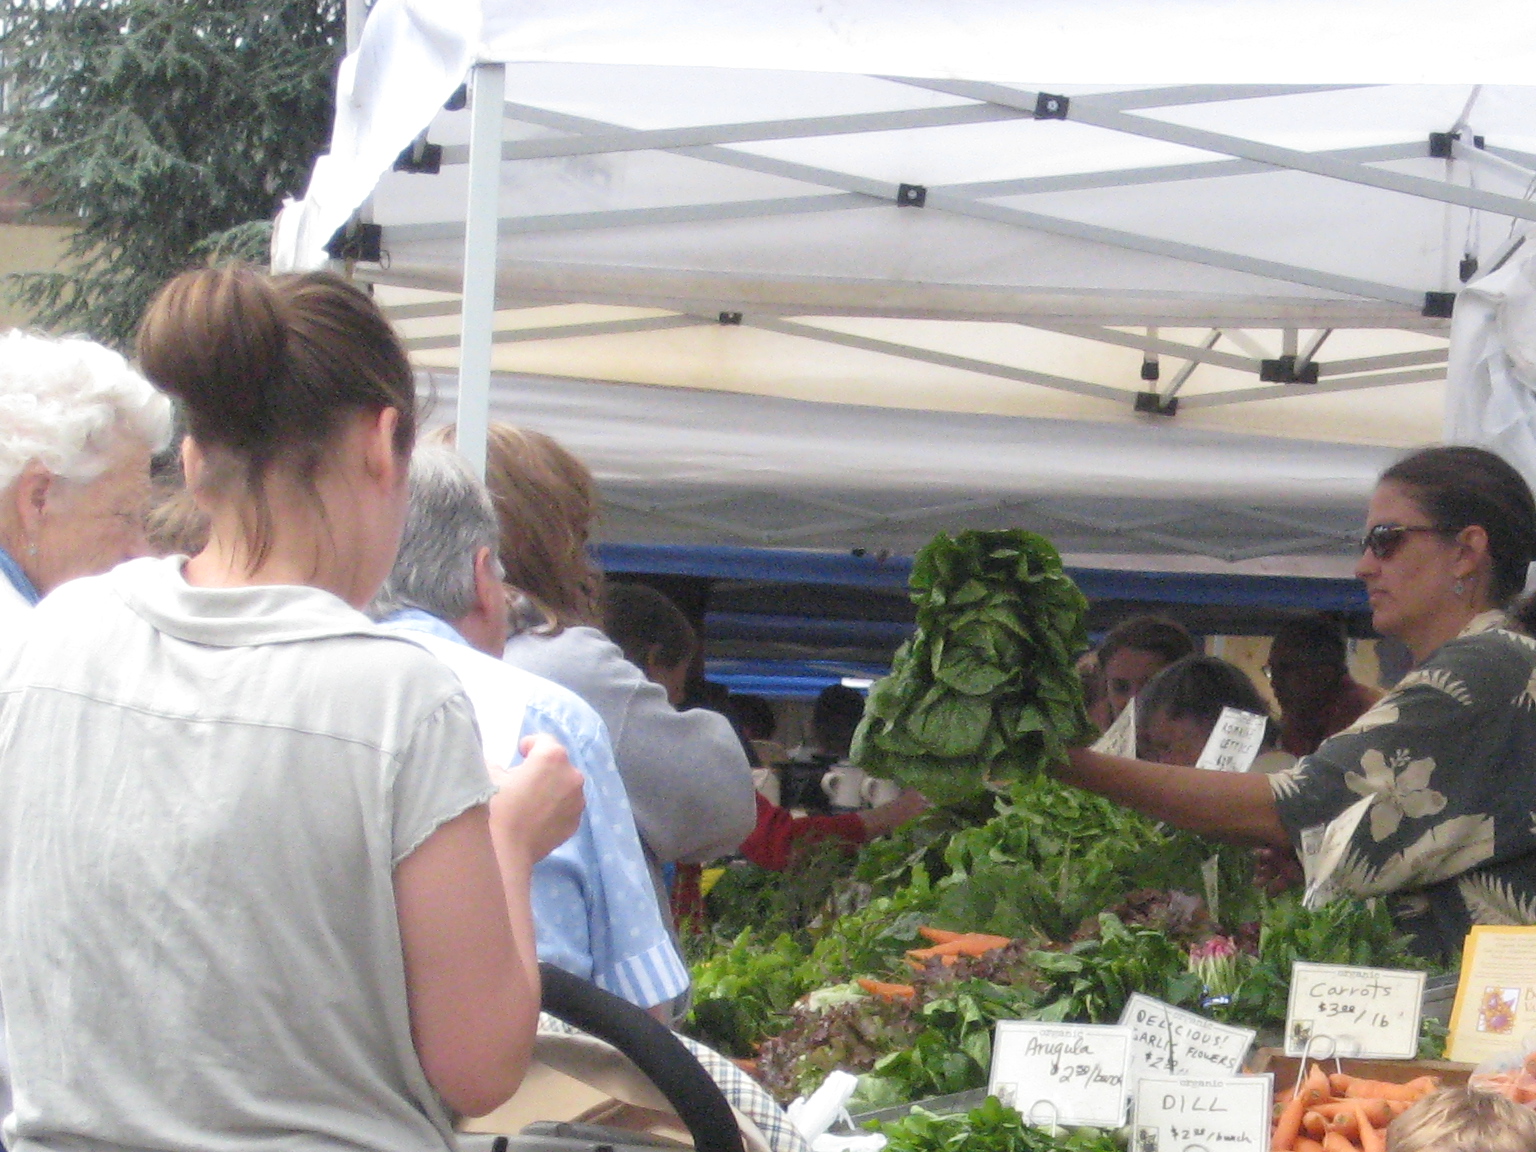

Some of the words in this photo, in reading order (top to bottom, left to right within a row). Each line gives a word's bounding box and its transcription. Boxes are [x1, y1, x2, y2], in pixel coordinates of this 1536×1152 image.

[1309, 979, 1393, 1000] Carrots
[1024, 1036, 1094, 1073] Arugula
[1185, 1046, 1238, 1069] FLOWERS
[1162, 1094, 1228, 1113] DILL
